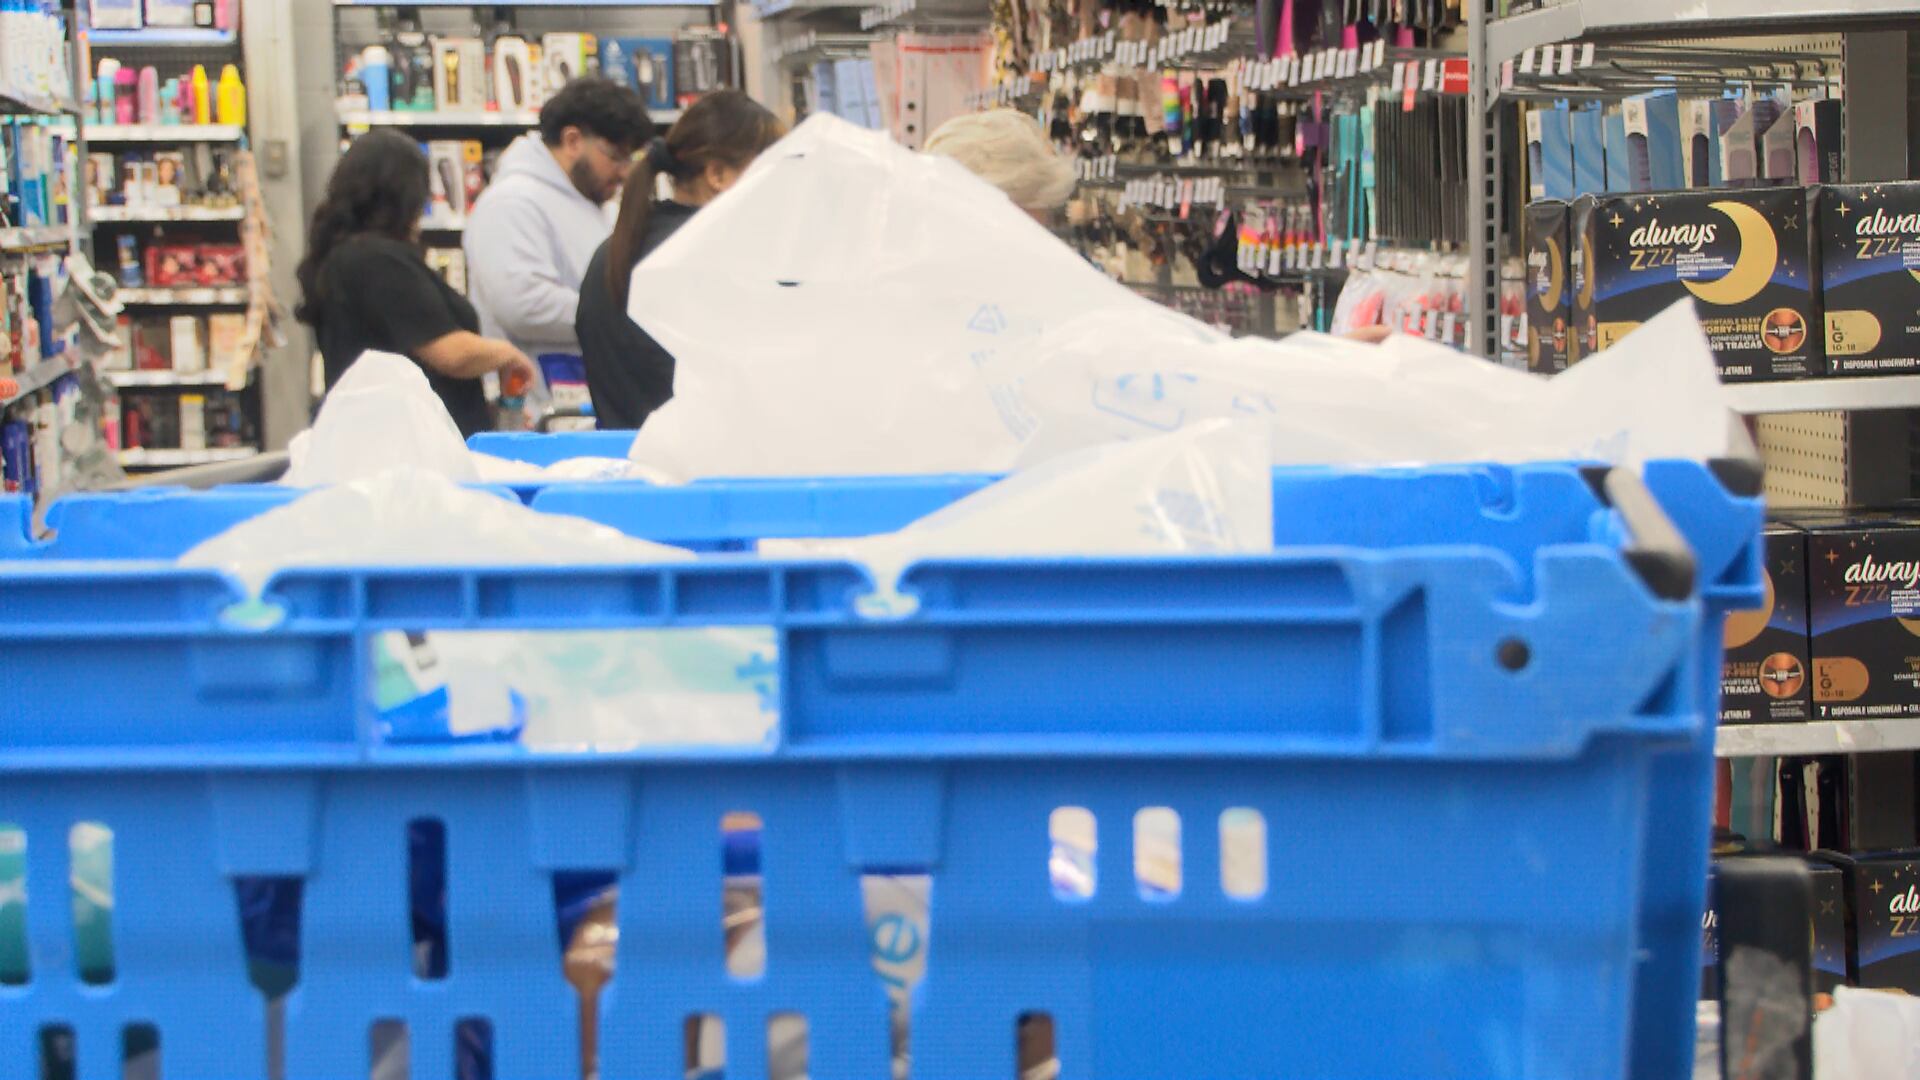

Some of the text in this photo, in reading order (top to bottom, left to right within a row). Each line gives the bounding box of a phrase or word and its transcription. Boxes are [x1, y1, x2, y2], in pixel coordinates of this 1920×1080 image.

[1629, 218, 1717, 252] always
[1832, 319, 1841, 331] L
[1605, 330, 1614, 341] L
[1832, 332, 1844, 344] G
[1844, 553, 1920, 590] alway
[1820, 666, 1829, 677] L
